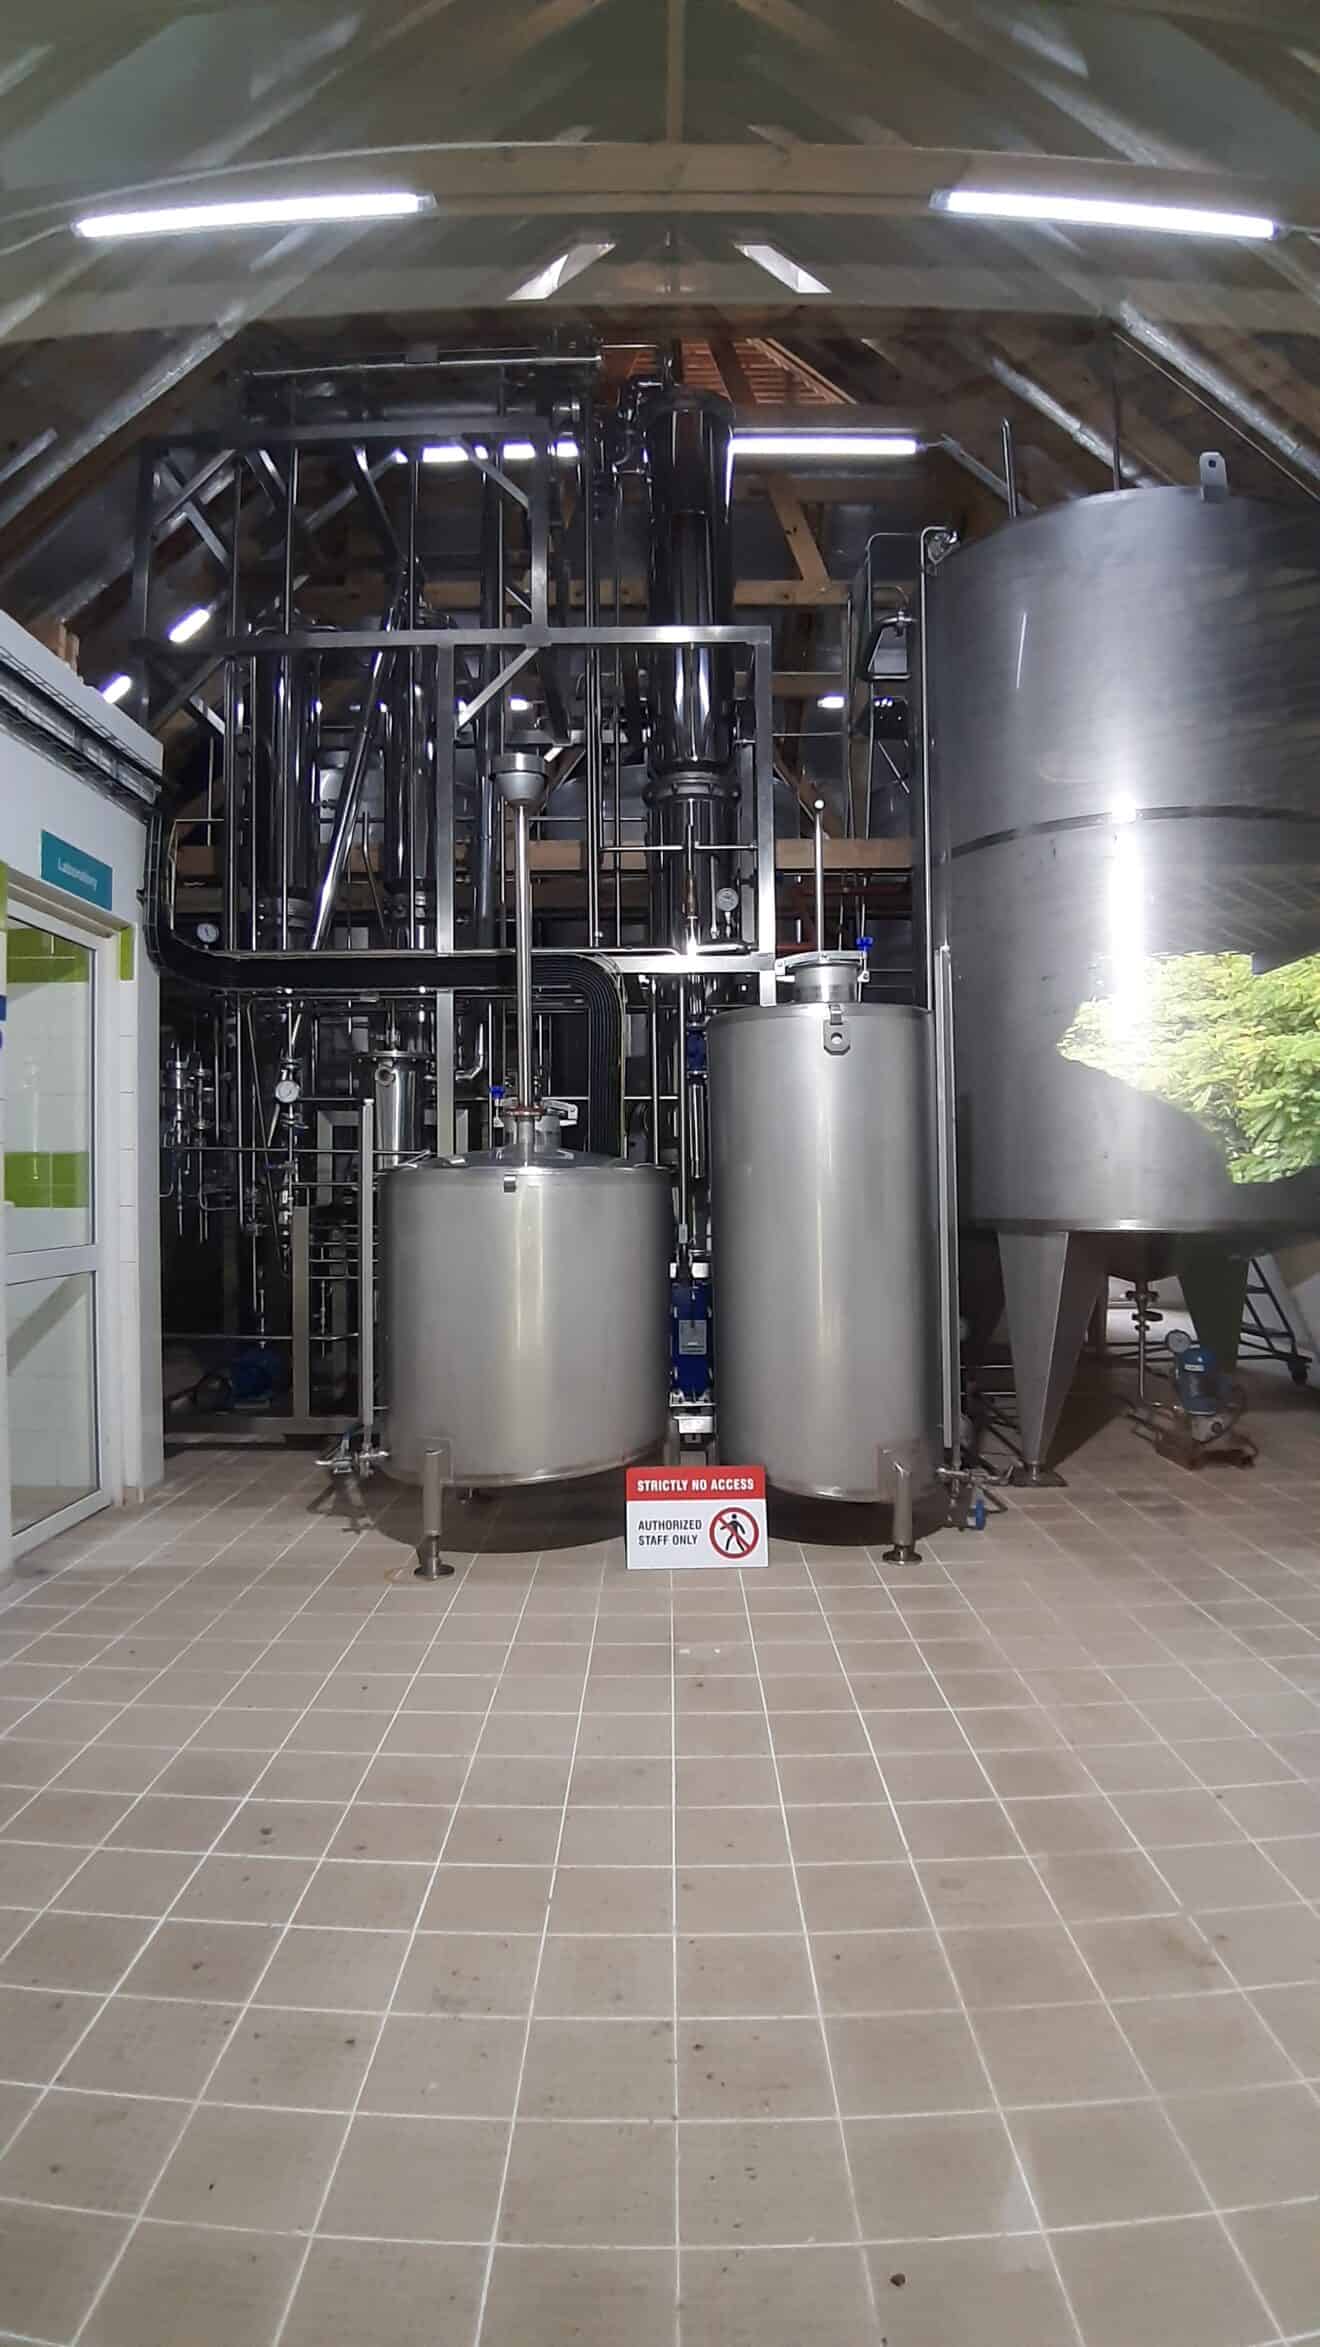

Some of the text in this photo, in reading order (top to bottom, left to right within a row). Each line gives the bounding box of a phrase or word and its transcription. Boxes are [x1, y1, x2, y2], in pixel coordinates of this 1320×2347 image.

[637, 1478, 754, 1492] STRICTLY NO ACCESS
[638, 1519, 702, 1531] AUTHORIZED
[639, 1534, 698, 1546] STAFF ONLY
